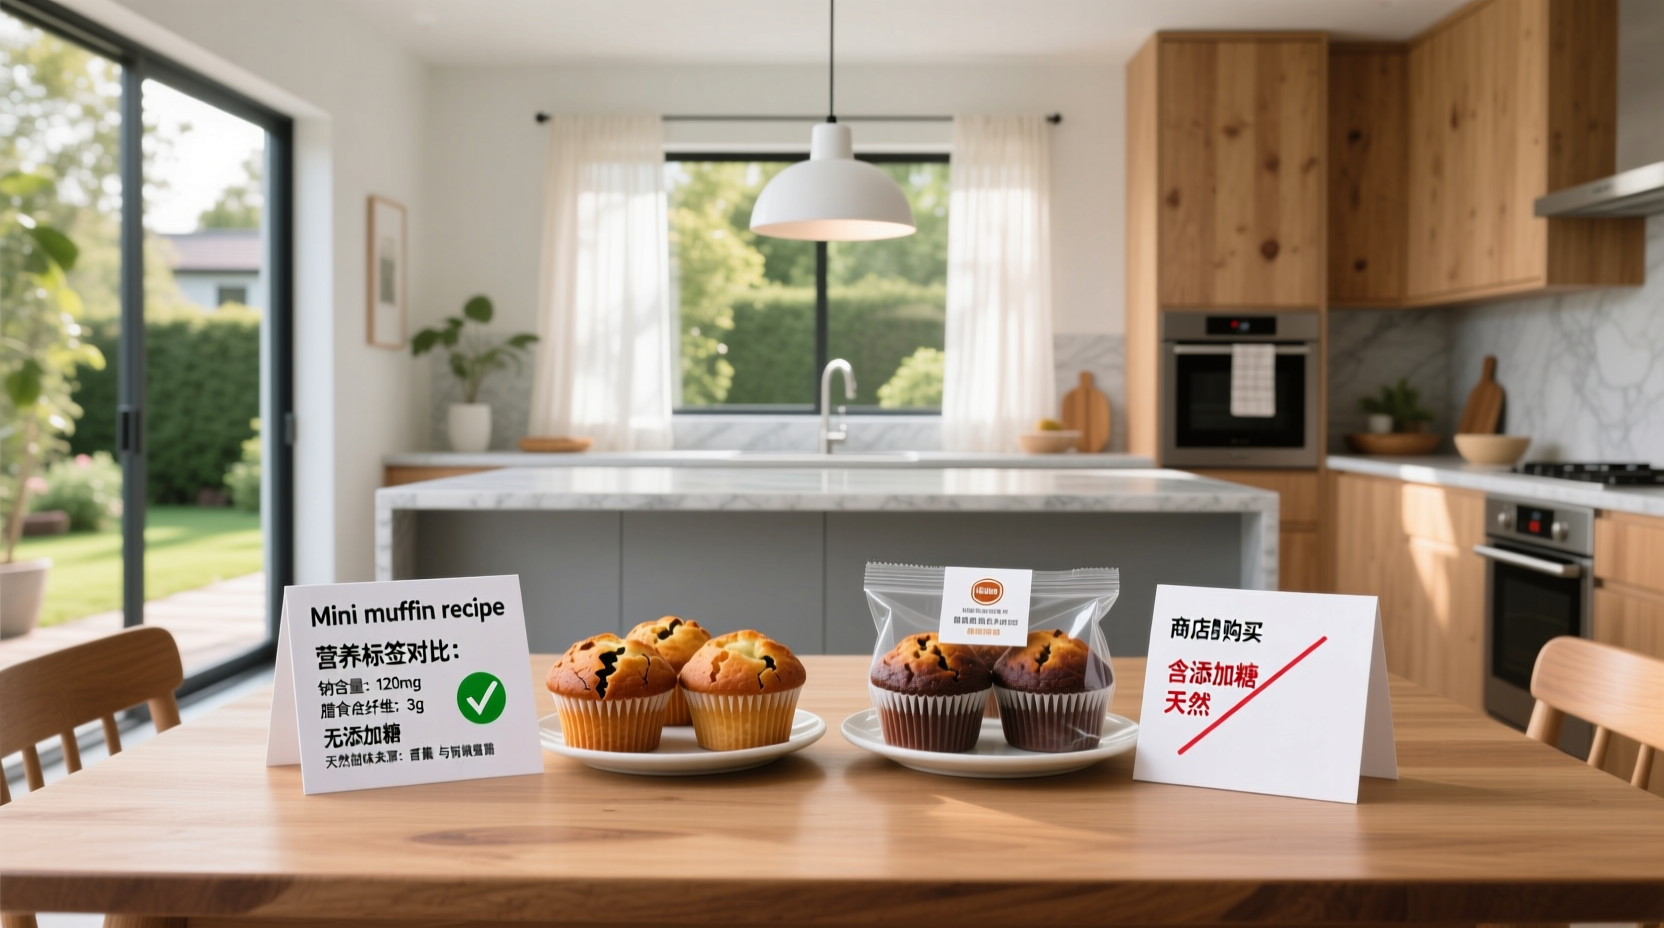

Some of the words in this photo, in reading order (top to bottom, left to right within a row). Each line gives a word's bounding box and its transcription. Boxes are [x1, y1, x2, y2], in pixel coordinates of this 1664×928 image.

[311, 604, 357, 627] Mini
[365, 600, 435, 624] muffin
[442, 597, 504, 622] recipe
[376, 677, 421, 692] 120mg
[1168, 659, 1259, 689] 含添加糖
[407, 698, 424, 714] 3g
[1164, 691, 1210, 716] 天然
[324, 722, 401, 748] 无添加糖
